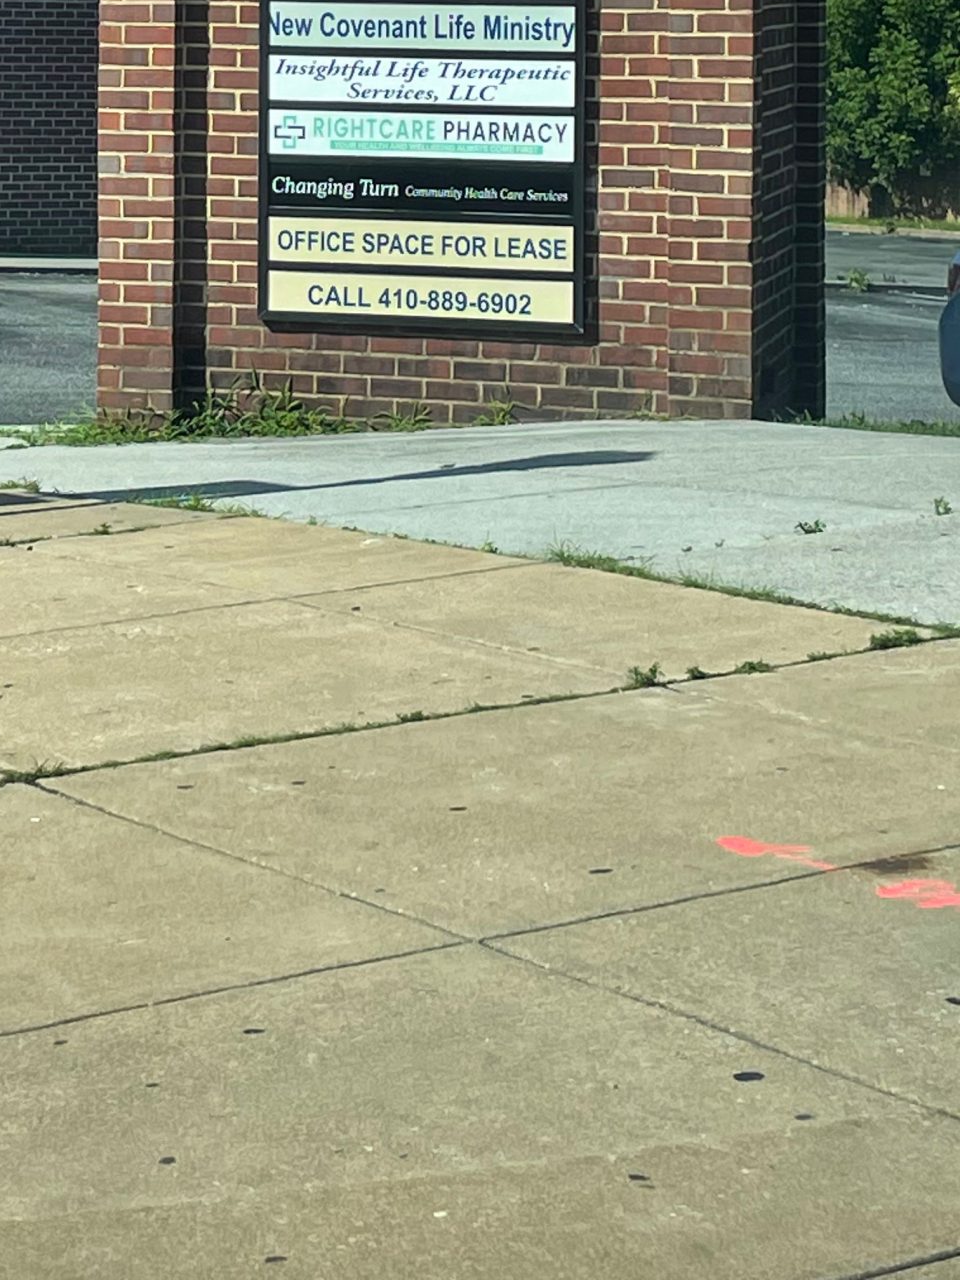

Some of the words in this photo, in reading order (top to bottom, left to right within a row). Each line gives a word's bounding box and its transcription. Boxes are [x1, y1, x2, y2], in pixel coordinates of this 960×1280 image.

[270, 11, 313, 37] New
[320, 12, 427, 38] Covenant
[434, 14, 475, 40] Life
[483, 15, 575, 47] Ministry
[275, 59, 381, 81] Insightful
[385, 60, 429, 81] Life
[438, 62, 571, 84] Therapeutic
[347, 82, 439, 102] Services,
[447, 84, 498, 102] LLC
[313, 117, 436, 140] RIGHTCARE
[443, 121, 568, 143] PHARMACY
[271, 176, 354, 199] Changing
[359, 178, 400, 196] Turn
[405, 185, 462, 200] Community
[464, 187, 497, 200] Health
[499, 188, 524, 201] Care
[526, 189, 569, 202] Services
[277, 230, 355, 252] OFFICE
[362, 233, 434, 255] SPACE
[441, 235, 487, 257] FOR
[493, 237, 567, 260] LEASE
[308, 285, 371, 308] CALL
[378, 287, 532, 315] 410-889-6902
